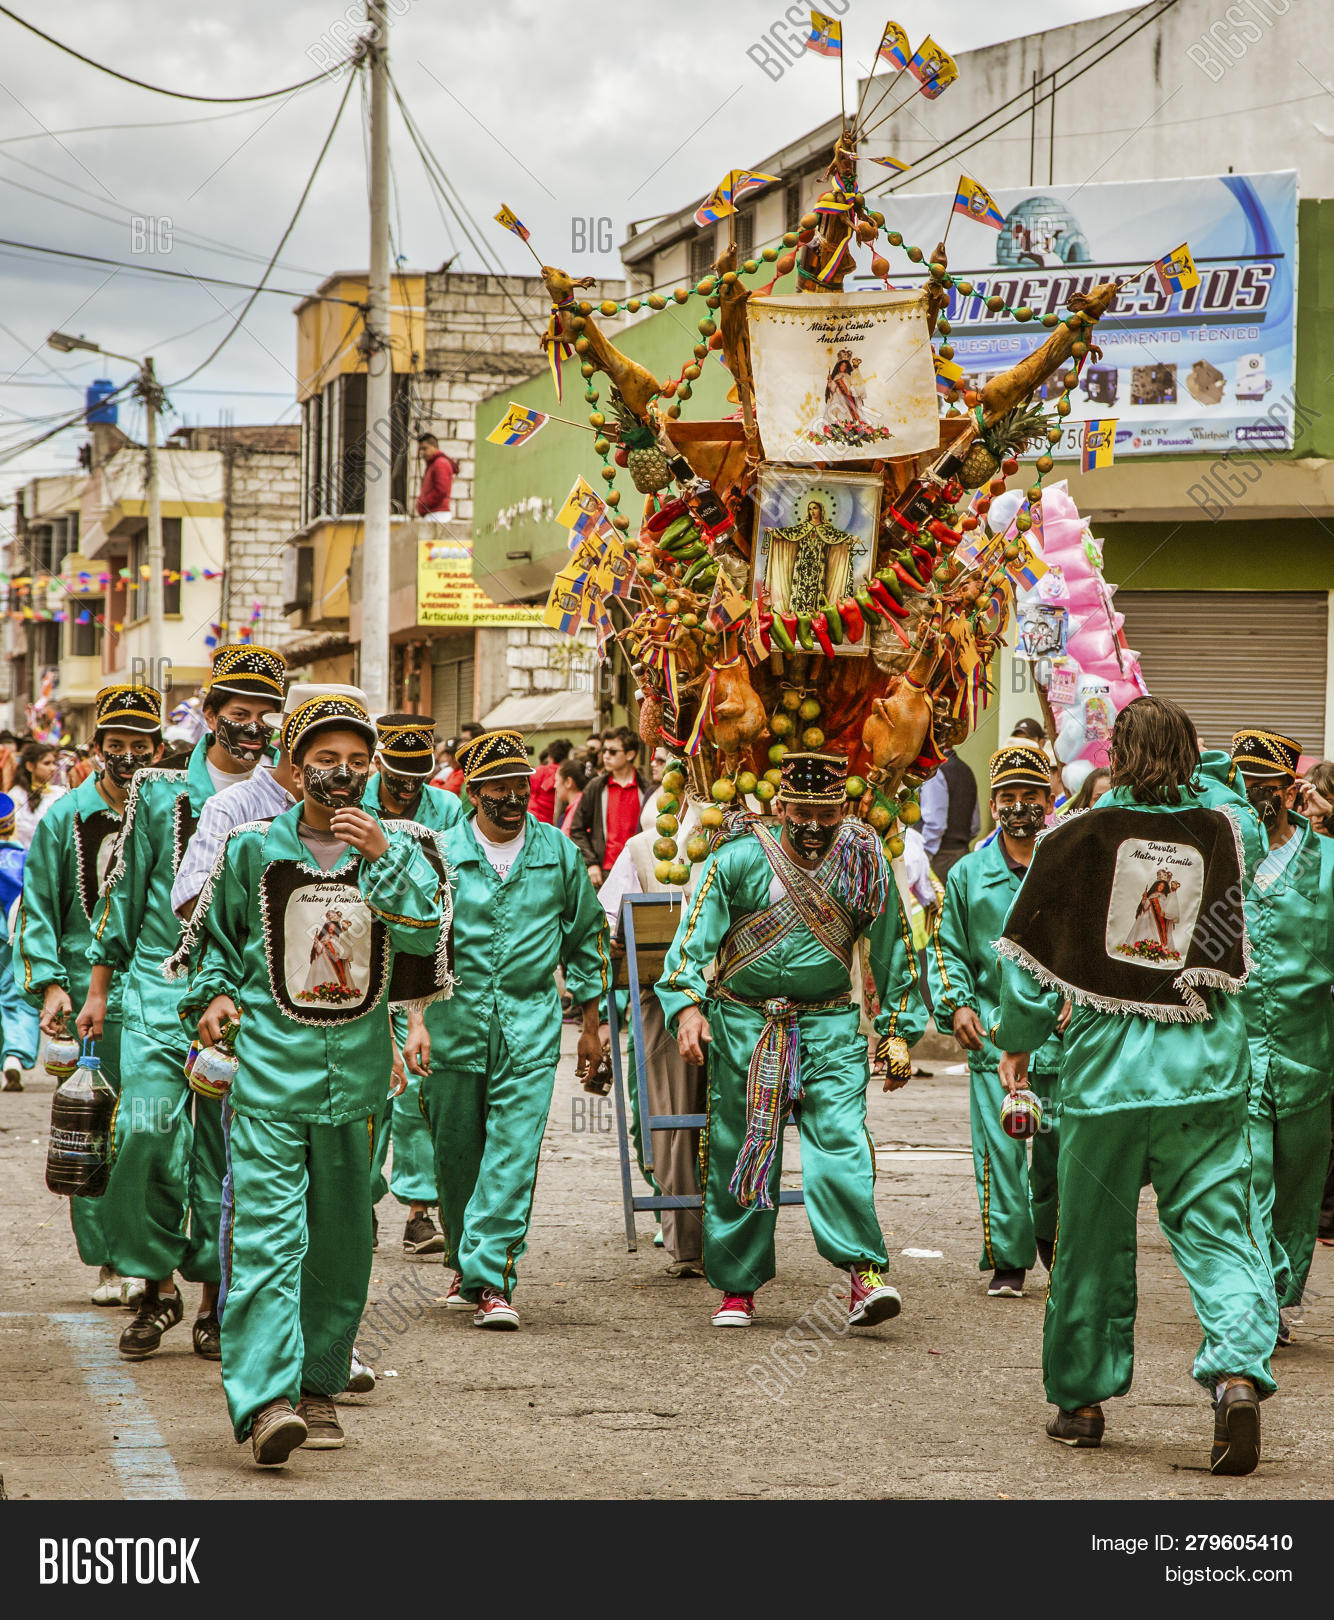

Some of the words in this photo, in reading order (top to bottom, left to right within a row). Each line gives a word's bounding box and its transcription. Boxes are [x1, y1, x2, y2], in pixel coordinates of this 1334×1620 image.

[837, 323, 845, 338] y
[1025, 336, 1038, 348] Y
[1189, 324, 1260, 342] TÉCNICO
[1129, 849, 1156, 861] Mateo
[1156, 856, 1164, 866] y
[1165, 855, 1193, 867] Camilo
[296, 894, 324, 903] Mateo
[324, 897, 332, 907] y
[333, 894, 362, 903] Camilo
